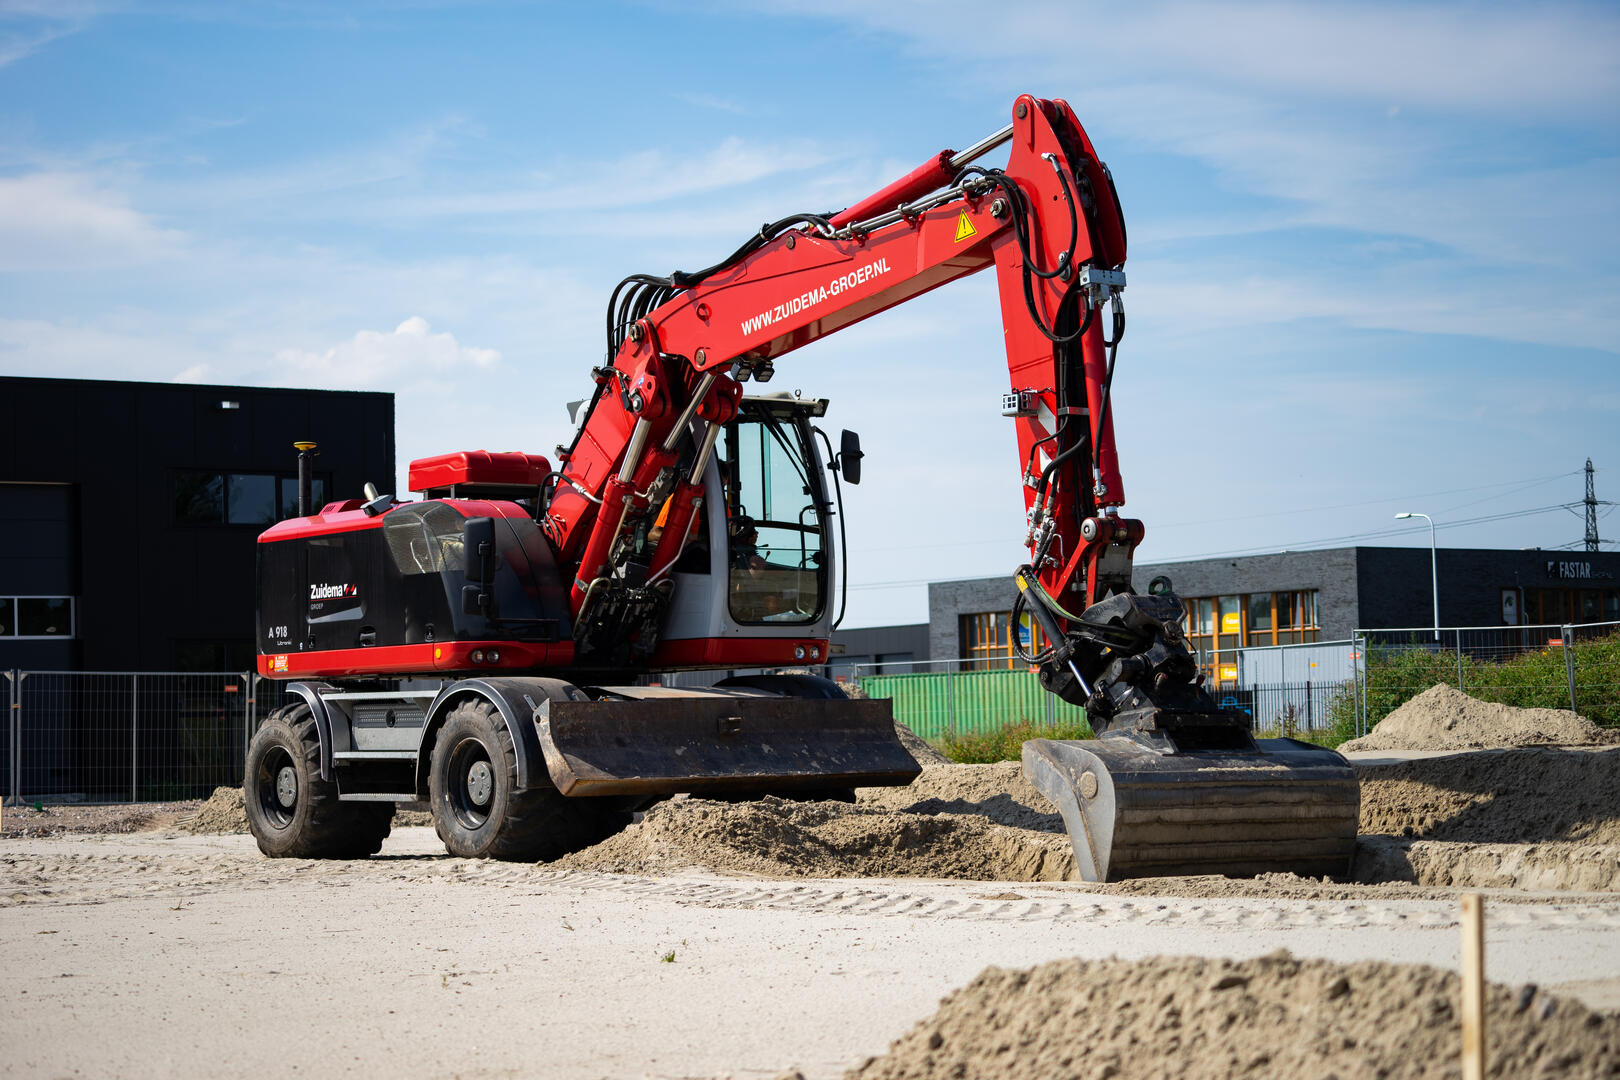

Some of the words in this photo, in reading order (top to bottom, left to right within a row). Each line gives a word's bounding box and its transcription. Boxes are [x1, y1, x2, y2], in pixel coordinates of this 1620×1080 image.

[741, 257, 891, 336] WWW.ZUIDEMA-GROEP.NL
[1559, 561, 1591, 579] FASTAR
[311, 583, 343, 599] Zuidema
[268, 627, 274, 638] A
[275, 626, 288, 638] 918
